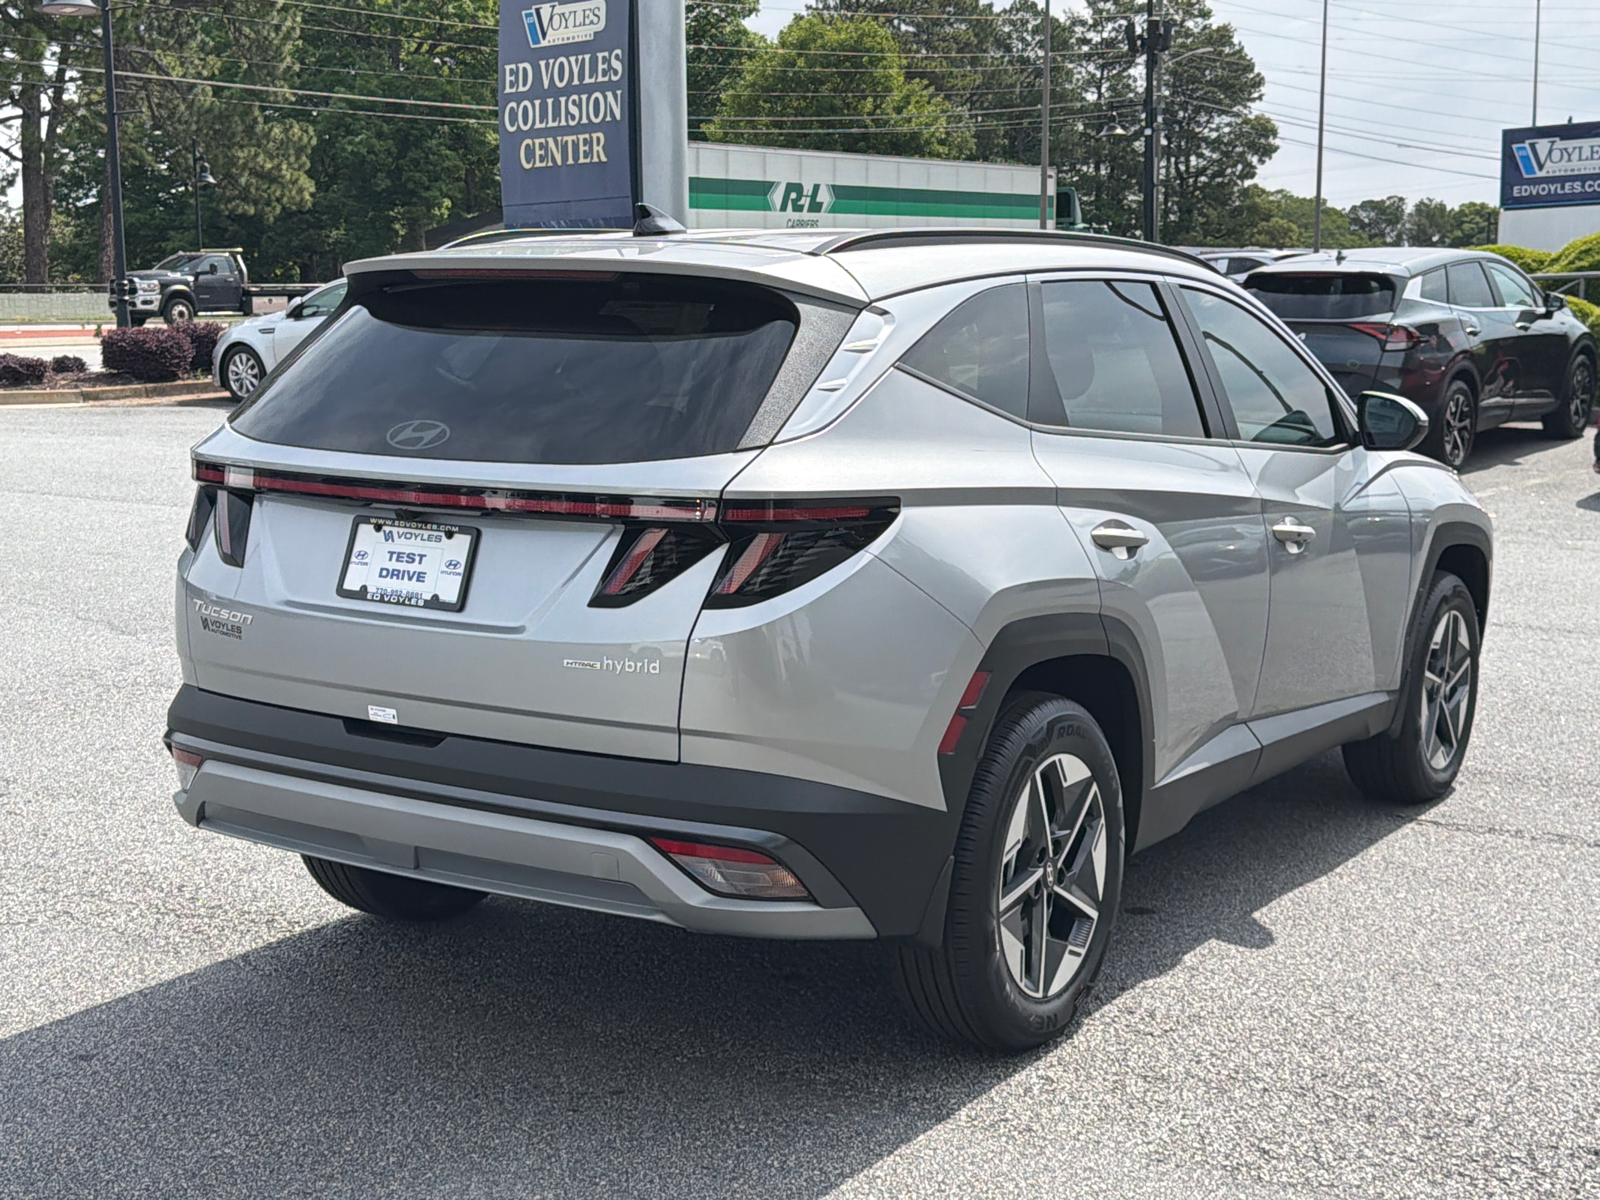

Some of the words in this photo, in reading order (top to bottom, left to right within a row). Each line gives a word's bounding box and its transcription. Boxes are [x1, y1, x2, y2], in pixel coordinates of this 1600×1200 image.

[534, 4, 601, 41] VOYLES
[548, 33, 592, 44] AUTOMOTIVE
[504, 62, 533, 94] ED
[539, 49, 623, 90] VOYLES
[504, 90, 622, 133] COLLISION
[520, 132, 608, 170] CENTER
[786, 218, 820, 229] CARRIERS
[397, 530, 443, 543] VOYLES
[387, 550, 428, 565] TEST
[378, 567, 428, 583] DRIVE
[366, 592, 381, 601] ED
[384, 594, 425, 606] VOYLES
[210, 618, 243, 635] VOYLES
[603, 656, 660, 675] hybrid
